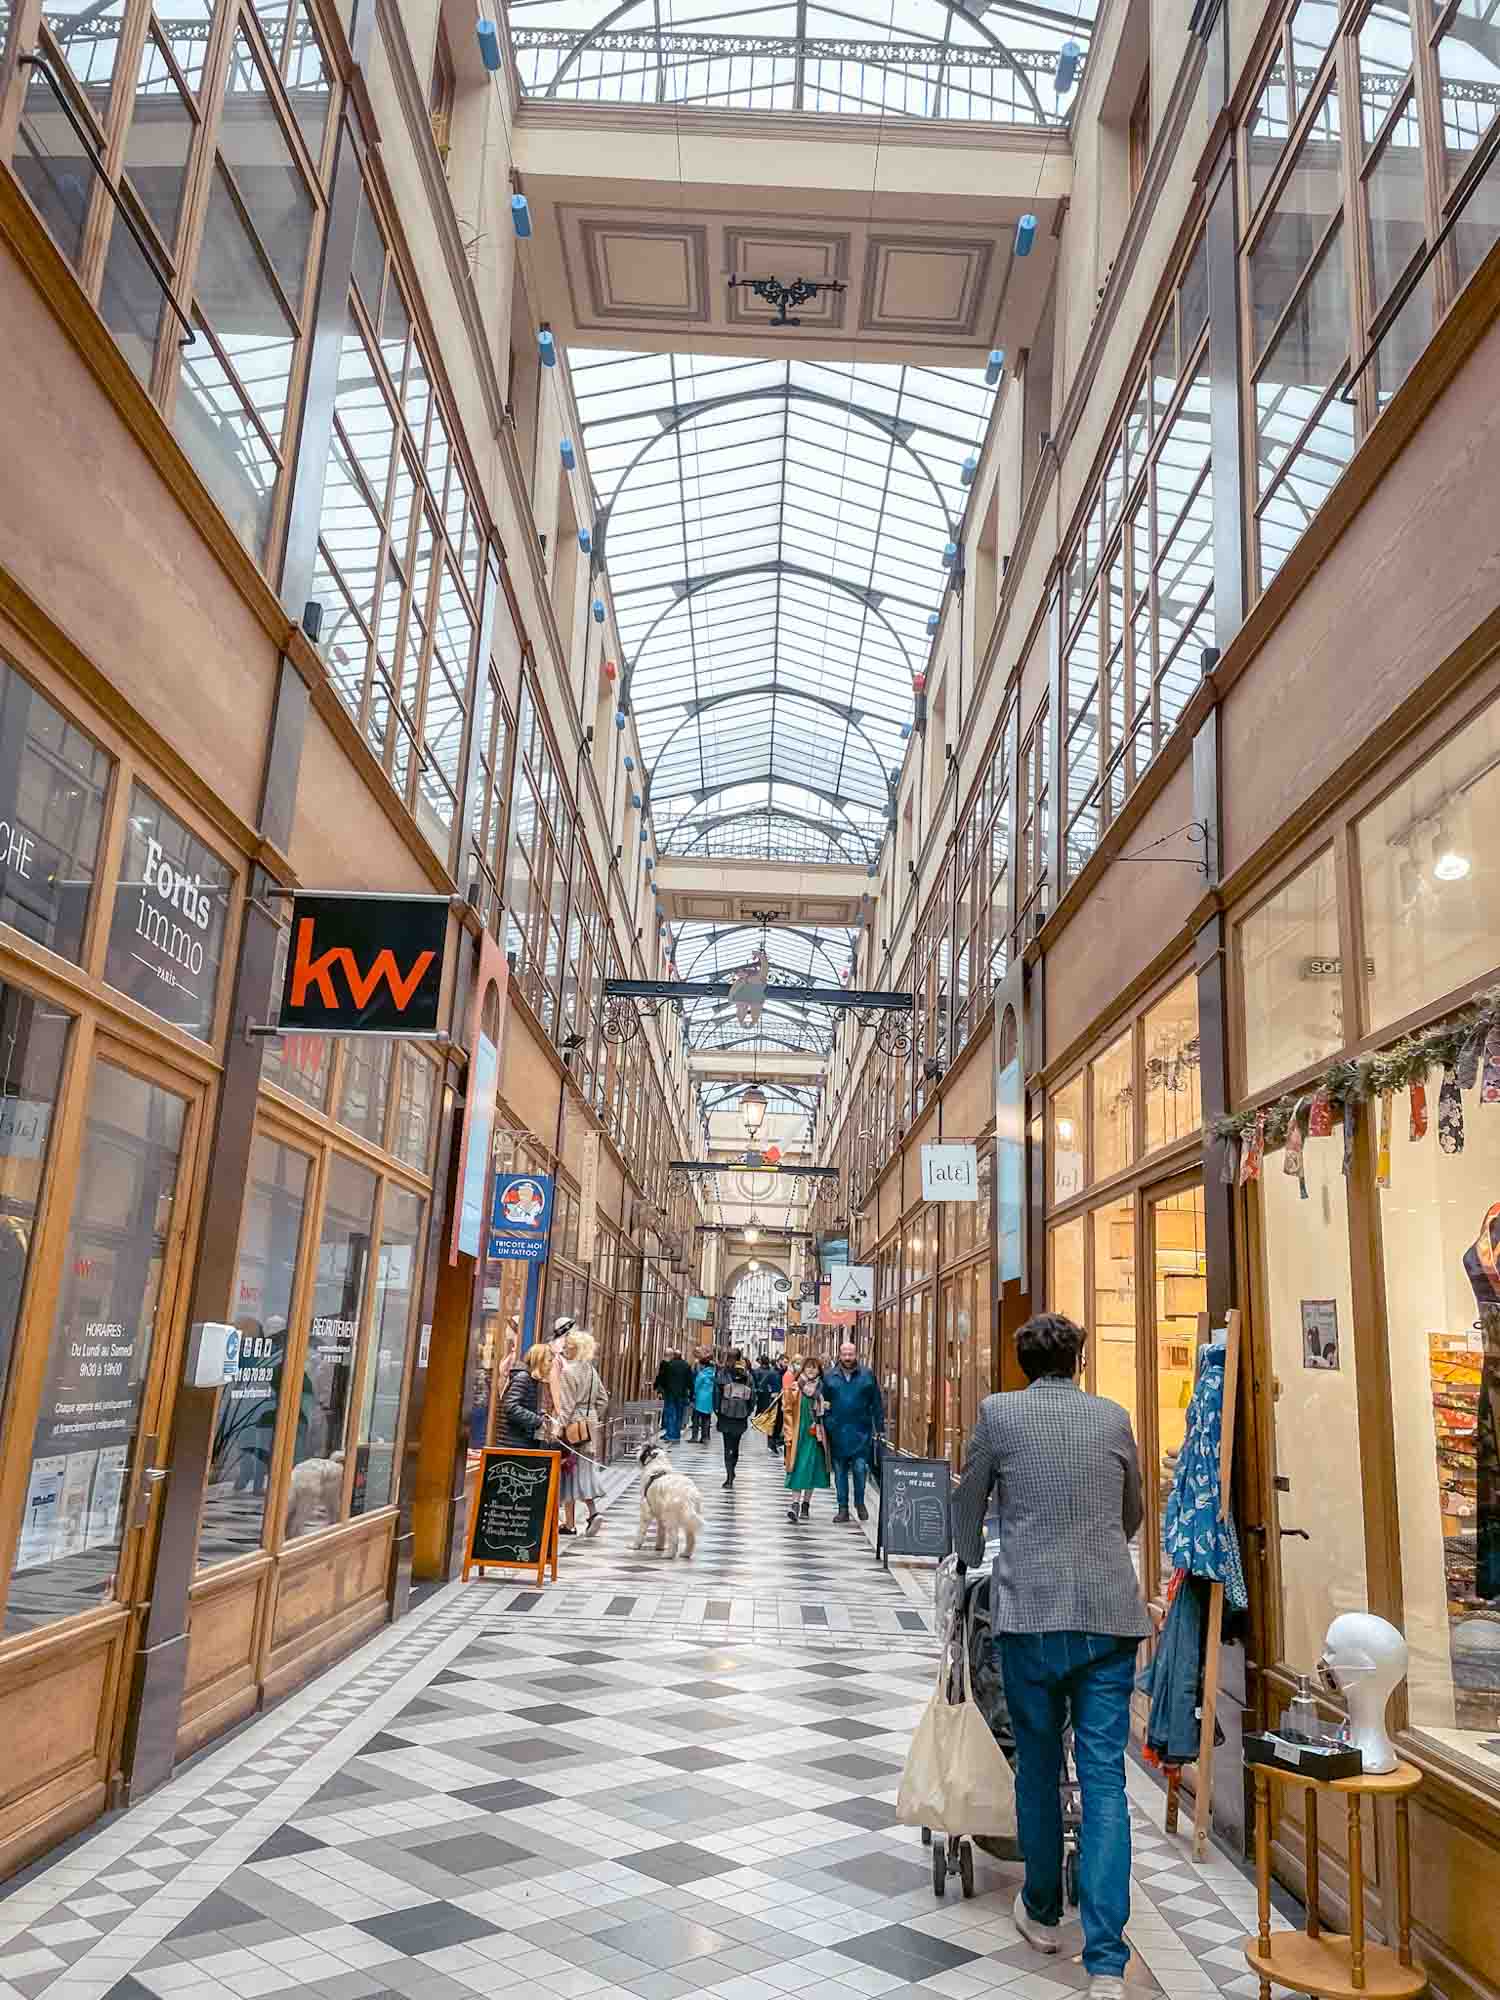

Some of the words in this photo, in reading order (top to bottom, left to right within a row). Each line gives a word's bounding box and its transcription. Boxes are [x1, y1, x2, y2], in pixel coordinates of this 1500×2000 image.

[143, 836, 210, 930] Fortis
[135, 888, 203, 975] immo
[290, 917, 436, 1011] kw
[496, 1240, 525, 1249] TRICOTE
[511, 1249, 538, 1257] TATTOO
[86, 1323, 121, 1337] HORAIRES
[72, 1343, 81, 1357] Du
[82, 1343, 100, 1357] Lundi
[101, 1347, 110, 1357] au
[110, 1343, 133, 1357] Samedi
[79, 1362, 96, 1377] 9h30
